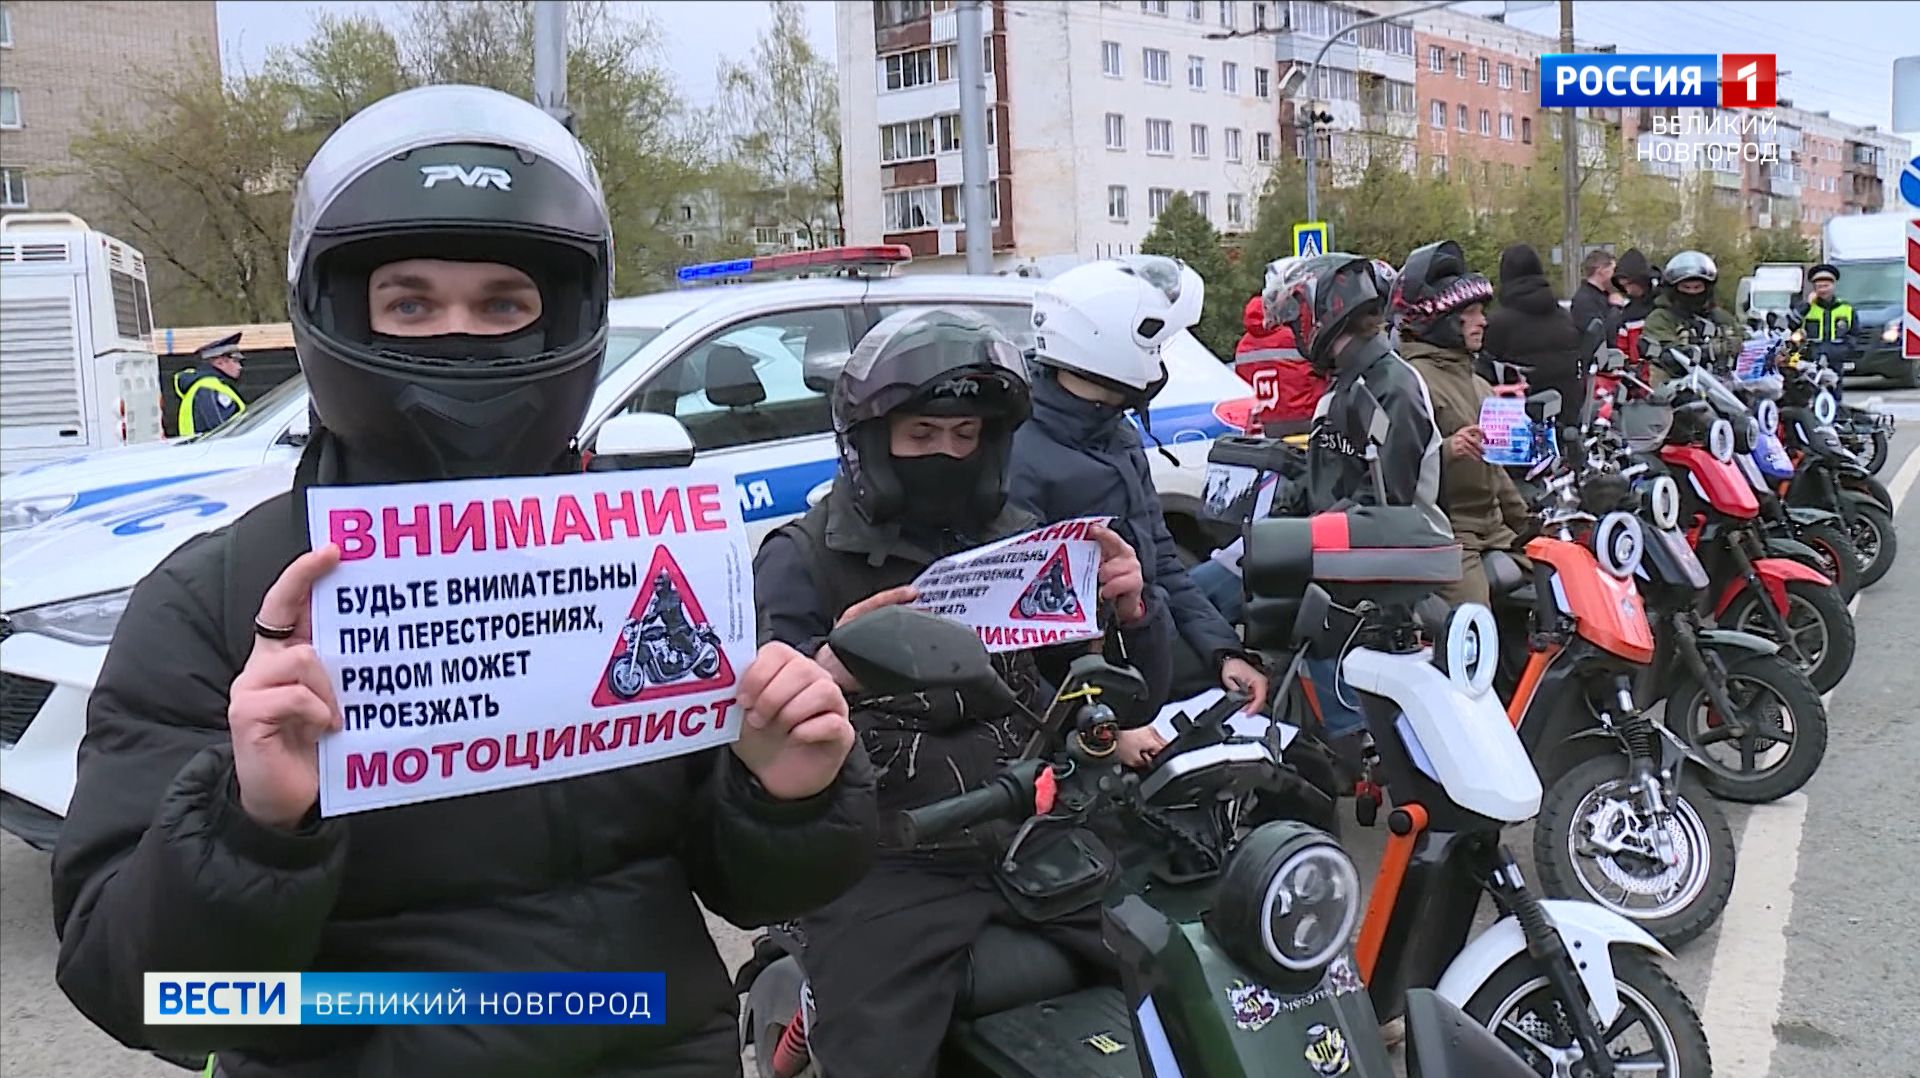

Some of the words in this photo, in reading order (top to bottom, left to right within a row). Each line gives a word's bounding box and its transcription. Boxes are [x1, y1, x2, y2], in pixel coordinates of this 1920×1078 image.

[420, 164, 512, 191] PVR
[328, 484, 728, 562] ВНИМАНИЕ
[336, 580, 439, 617] БУДЬТЕ
[446, 562, 638, 605] ВНИМАТЕЛЬНЫ
[339, 626, 390, 655] ПРИ
[398, 604, 604, 651] ПЕРЕСТРОЕНИЯХ,
[341, 662, 434, 695] РЯДОМ
[441, 650, 532, 684] МОЖЕТ
[343, 693, 500, 731] ПРОЕЗЖАТЬ
[345, 697, 738, 791] МОТОЦИКЛИСТ
